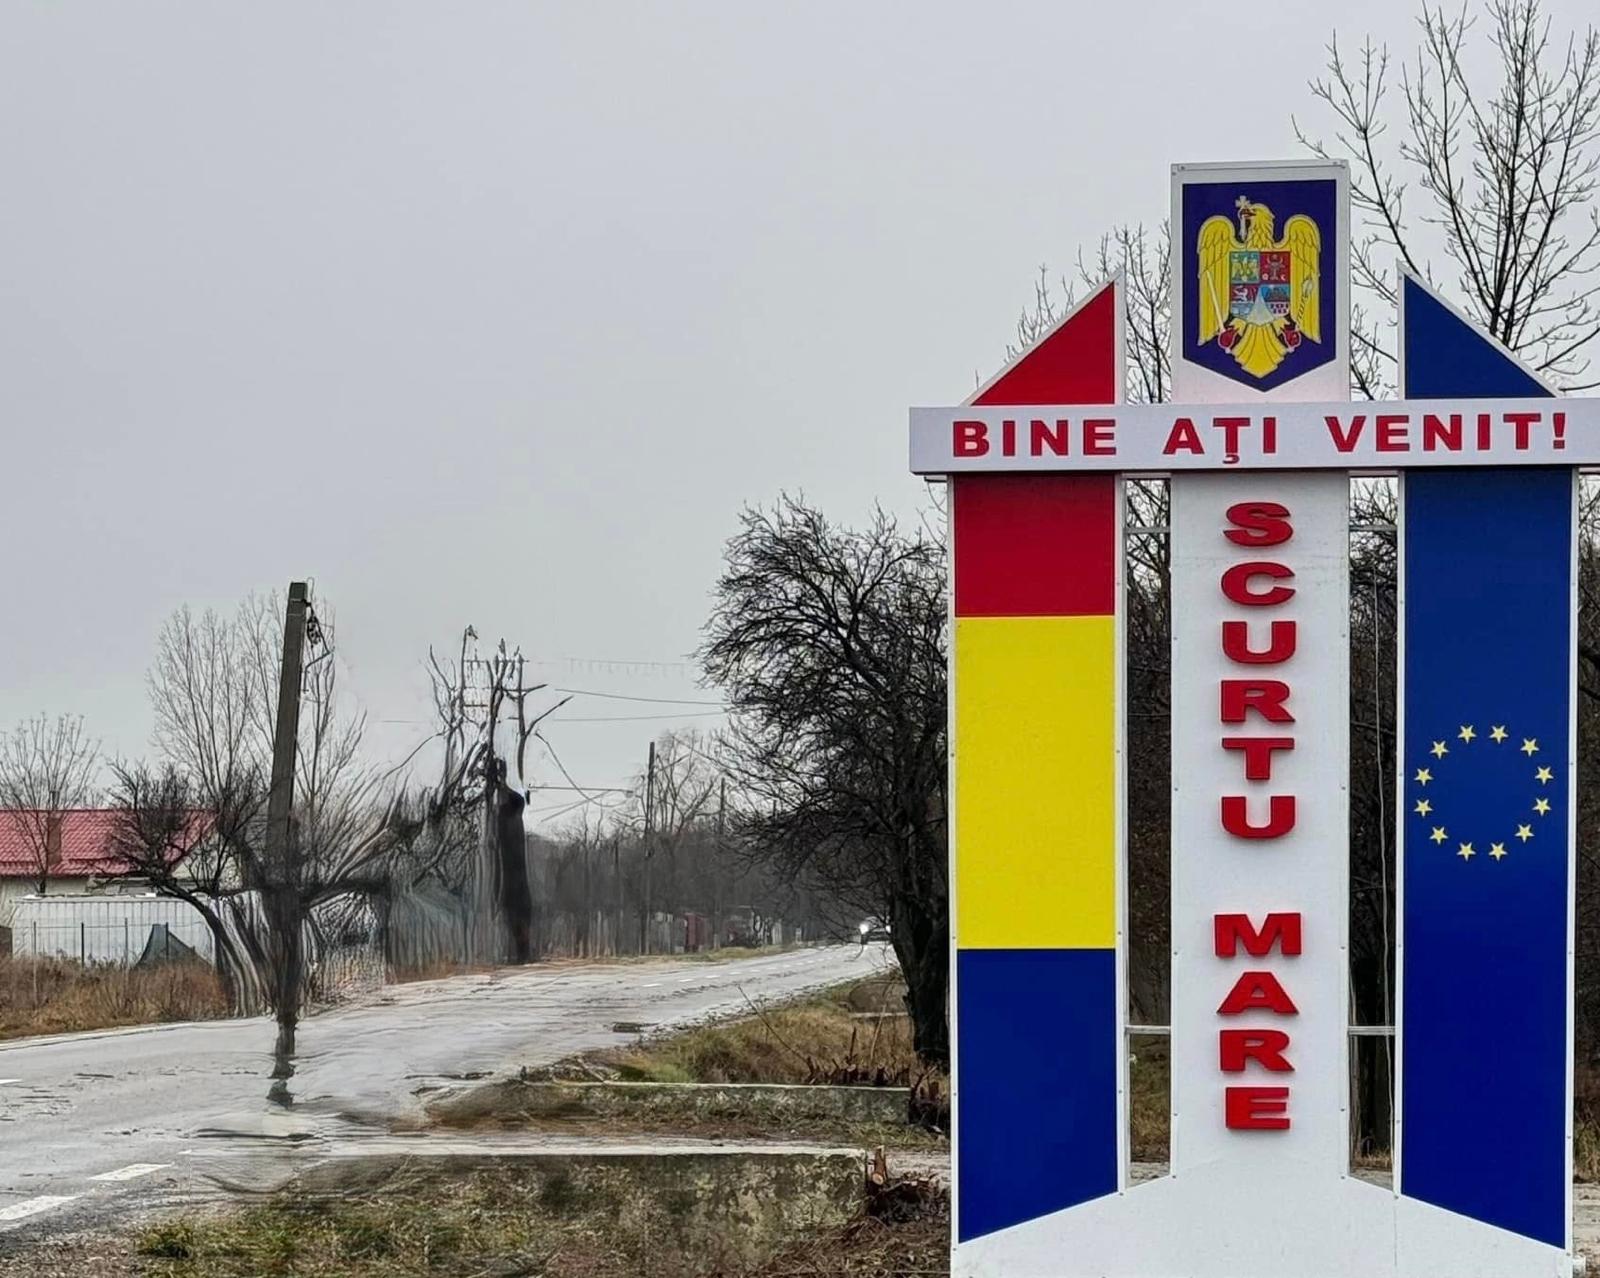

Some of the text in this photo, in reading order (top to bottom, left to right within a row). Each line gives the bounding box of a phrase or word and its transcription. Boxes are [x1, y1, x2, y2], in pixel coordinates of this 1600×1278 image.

[952, 420, 1118, 458] BINE
[1325, 412, 1567, 454] VENIT!
[1213, 502, 1303, 1131] SCURTU MARE
